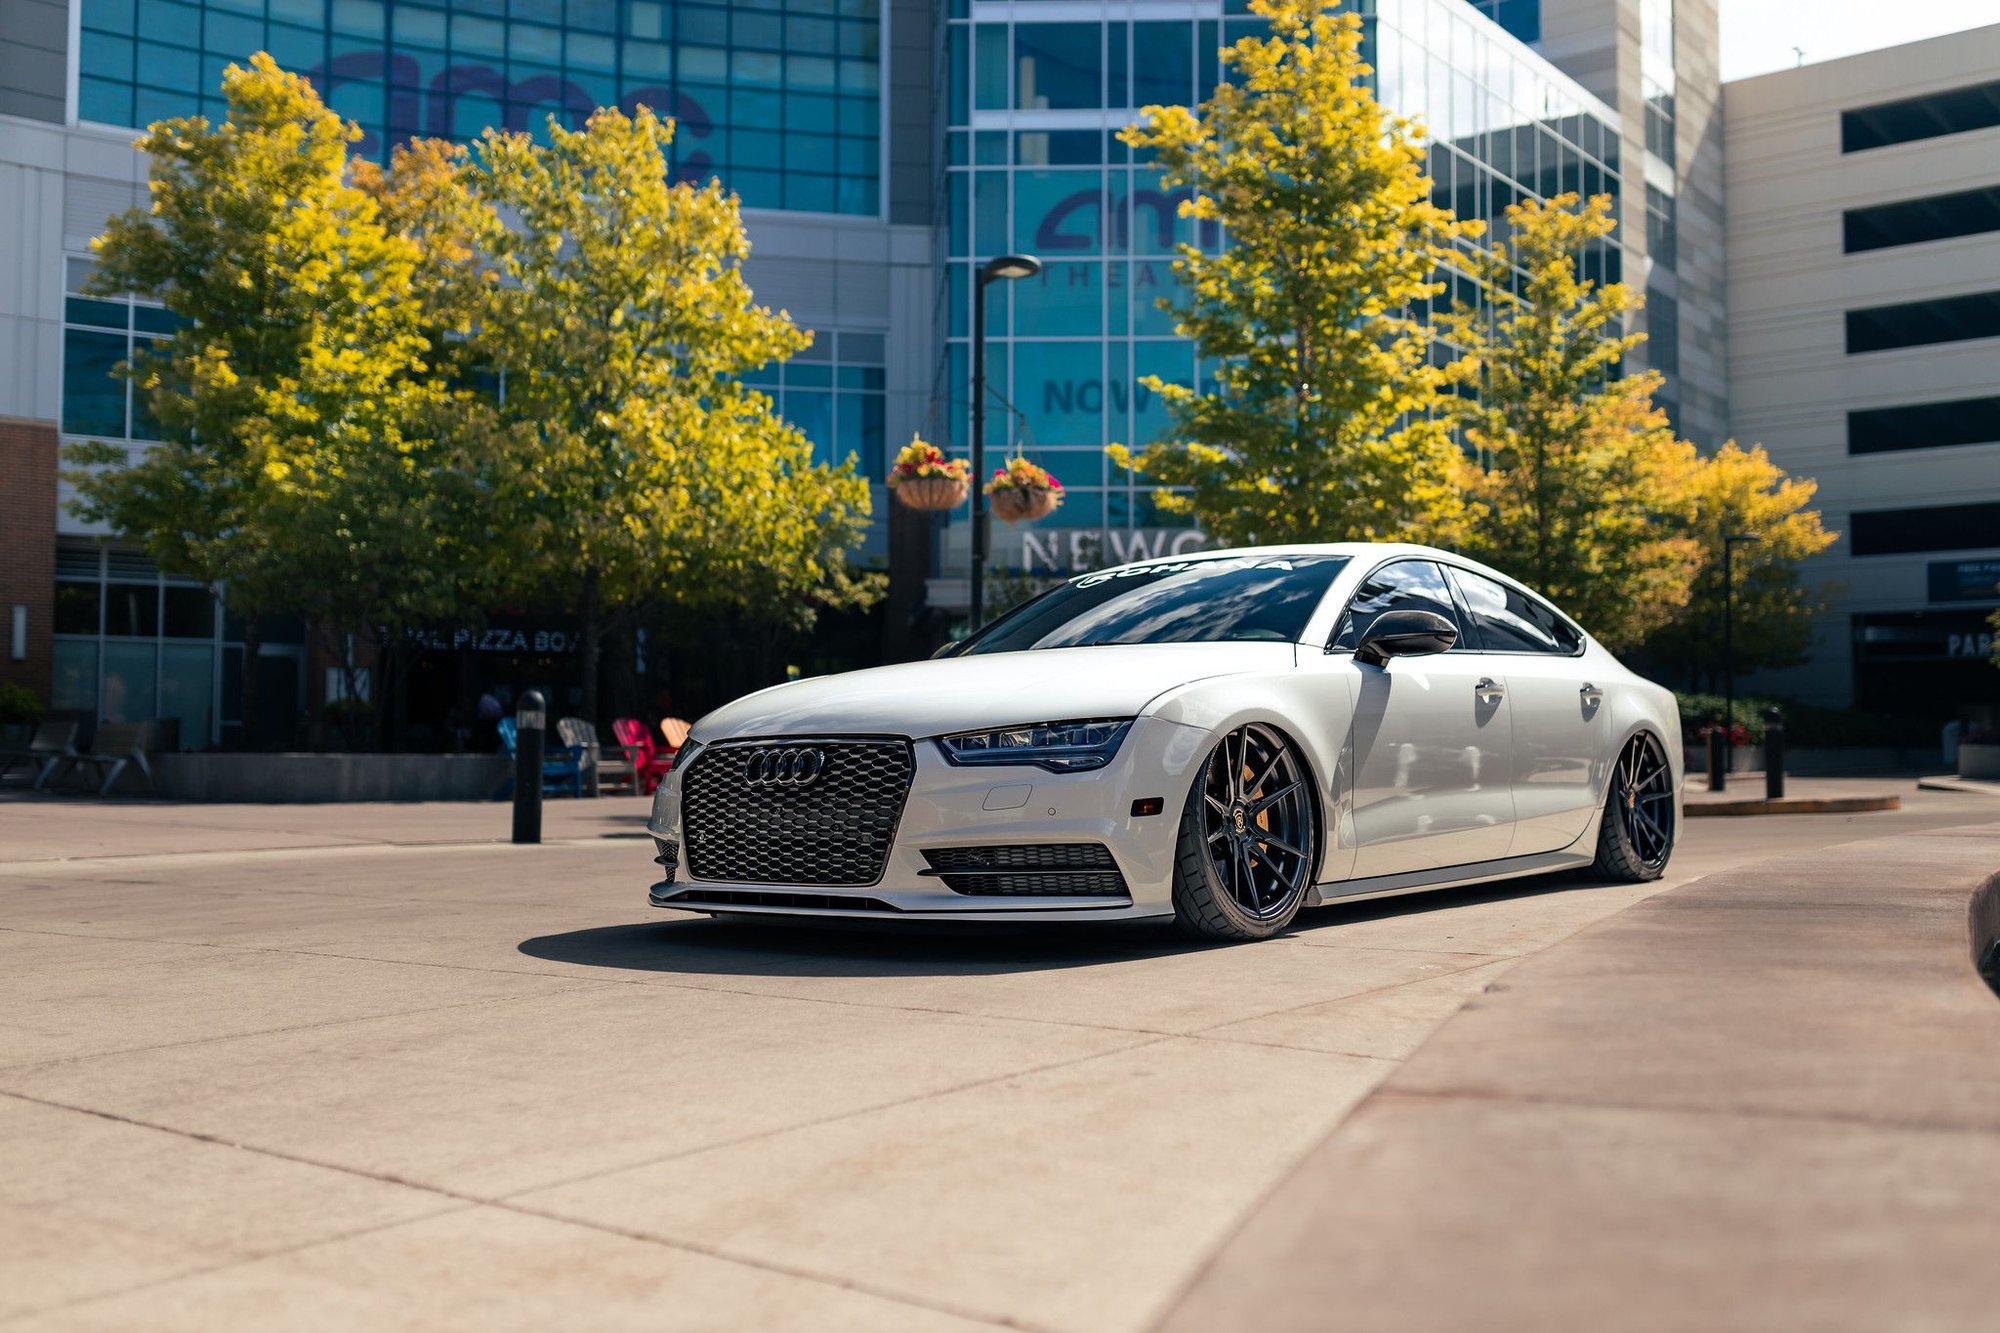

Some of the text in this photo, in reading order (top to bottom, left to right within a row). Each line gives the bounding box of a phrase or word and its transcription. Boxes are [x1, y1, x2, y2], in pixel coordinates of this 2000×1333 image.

[1036, 188, 1243, 250] am
[1043, 379, 1155, 414] NOW
[453, 628, 528, 651] PIZZA
[1947, 633, 1992, 657] PAR
